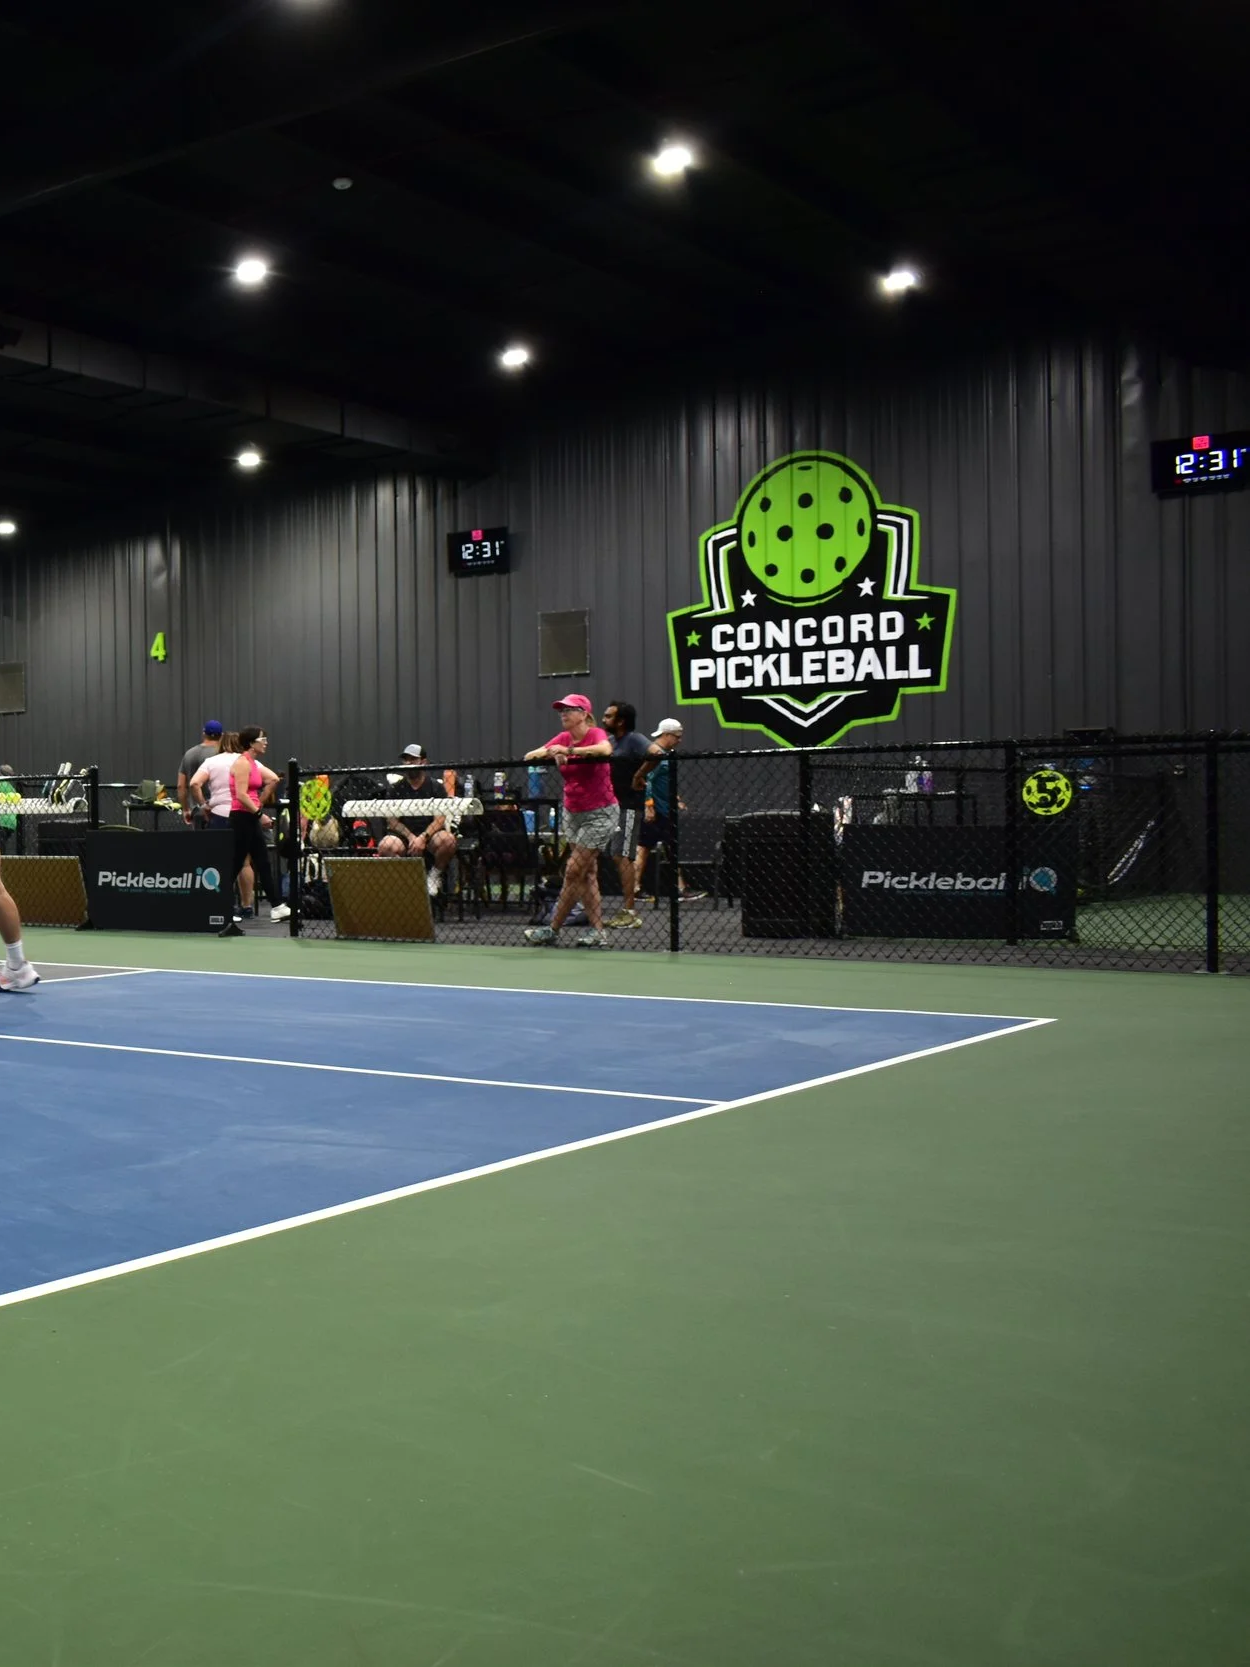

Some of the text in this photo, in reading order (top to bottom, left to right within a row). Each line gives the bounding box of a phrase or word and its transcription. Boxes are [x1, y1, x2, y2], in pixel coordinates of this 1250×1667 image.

[1175, 449, 1238, 475] 12:31
[461, 541, 500, 559] 12:31
[711, 610, 905, 652] CONCORD
[150, 632, 167, 661] 4
[690, 644, 932, 691] PICKLEBALL
[1036, 775, 1060, 808] 5
[97, 867, 221, 893] Pickleball iQ
[861, 870, 1008, 890] Picklebal
